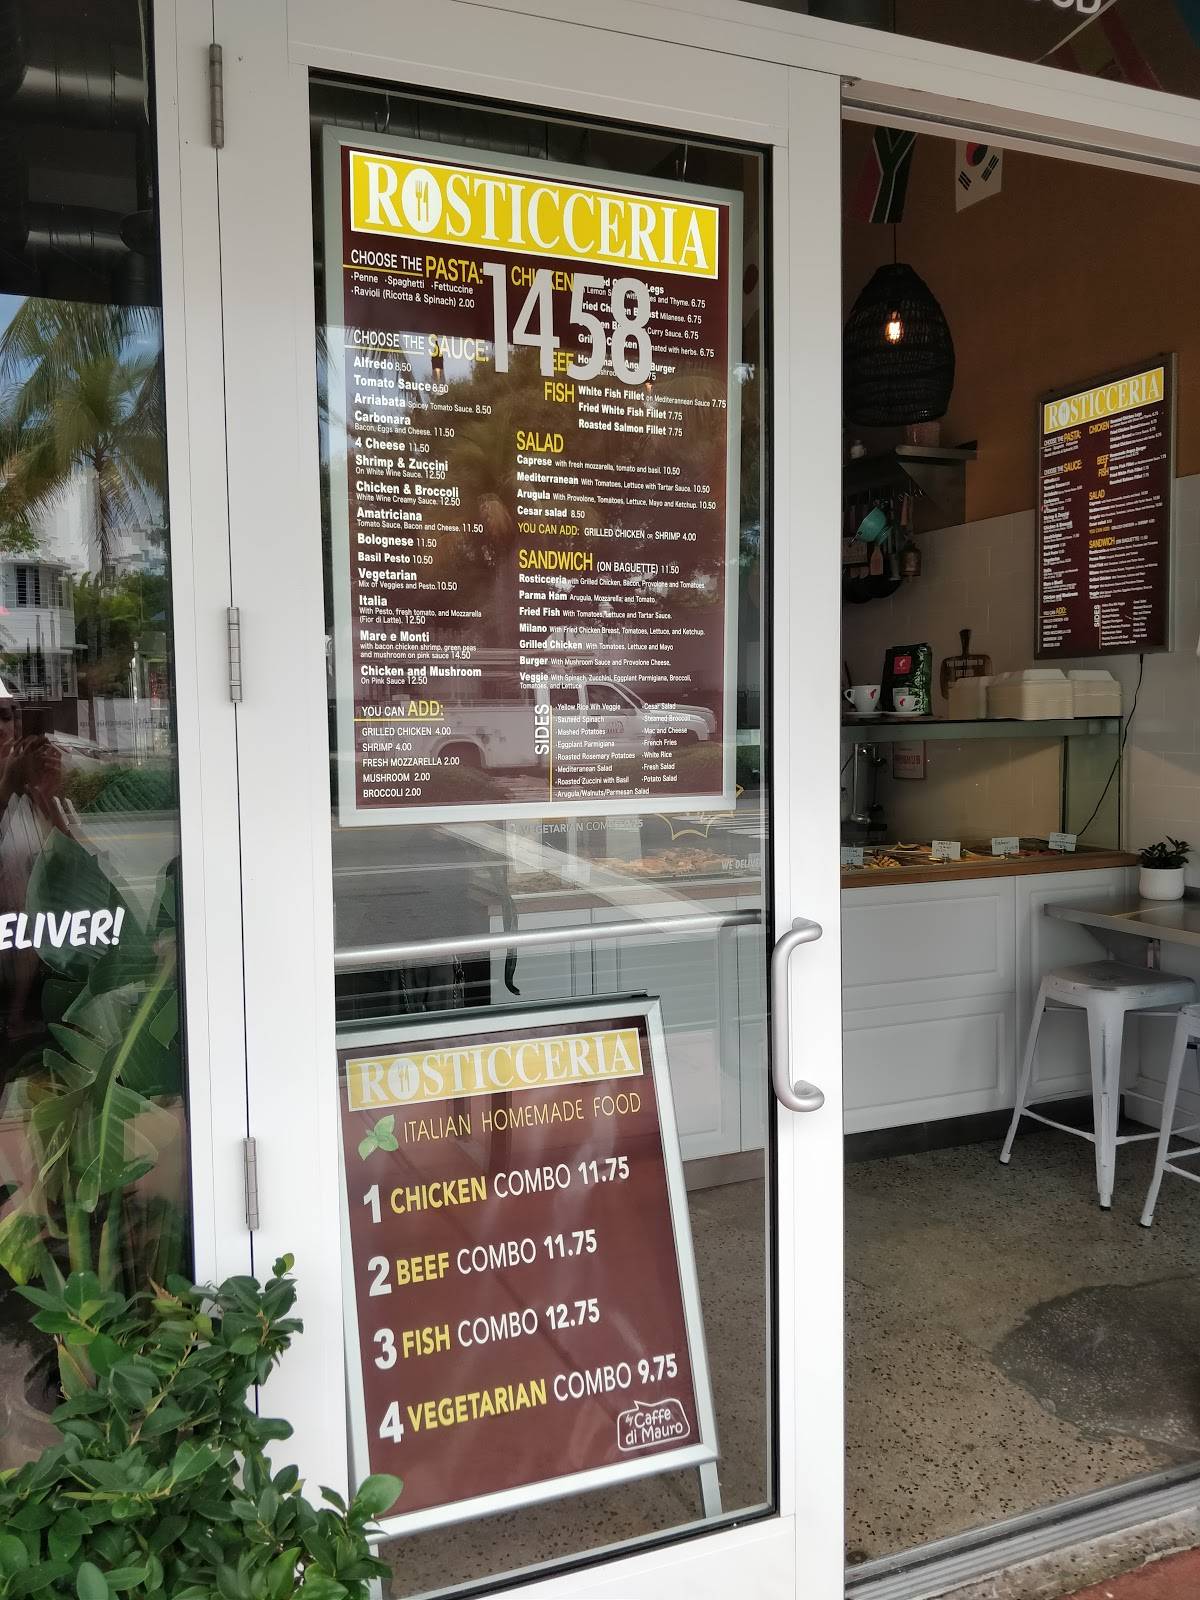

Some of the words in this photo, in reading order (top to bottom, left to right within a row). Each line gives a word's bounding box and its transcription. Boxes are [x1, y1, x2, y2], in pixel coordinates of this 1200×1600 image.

[365, 161, 709, 270] ROSTICCERIA
[351, 249, 398, 268] CHOOSE
[401, 256, 422, 271] THE
[426, 256, 483, 284] PASTA:
[354, 272, 378, 283] Penne
[388, 276, 424, 289] Spaghetti
[434, 281, 473, 294] Fettuccine
[354, 287, 380, 298] Ravioli
[383, 290, 413, 302] (Ricotta
[424, 294, 456, 307] Spinach)
[459, 298, 474, 308] 2.00
[691, 299, 706, 309] 6.75
[483, 262, 653, 385] 1458
[687, 315, 702, 324] 6.75
[685, 330, 699, 339] 6.75
[353, 329, 399, 347] CHOOSE
[403, 335, 424, 350] THE
[428, 334, 489, 362] SAUCE:
[700, 349, 714, 357] 6.75
[354, 356, 393, 370] Alfredo
[354, 374, 394, 388] Tomato
[398, 378, 431, 392] Sauce
[544, 381, 575, 403] FISH
[578, 385, 602, 396] White
[605, 388, 621, 398] Fish
[624, 389, 644, 400] Fillet
[354, 393, 406, 408] Arriabata
[476, 404, 492, 414] 8.50
[712, 399, 726, 408] 7.75
[1048, 372, 1160, 430] ROSTICCERIA
[354, 410, 411, 425] Carbonara
[578, 402, 599, 413] Fried
[602, 404, 625, 415] White
[627, 405, 643, 417] Fish
[646, 407, 666, 419] Fillet
[668, 412, 682, 421] 7.75
[434, 427, 454, 437] 11.50
[578, 419, 611, 431] Roasted
[614, 421, 643, 434] Salmon
[646, 424, 666, 435] Fillet
[668, 427, 682, 437] 7.75
[355, 437, 362, 448] 4
[366, 438, 406, 451] Cheese
[516, 430, 564, 453] SALAD
[356, 455, 393, 469] Shrimp
[398, 457, 405, 469] &
[409, 458, 448, 471] Zuccini
[517, 454, 552, 467] Caprese
[426, 470, 445, 480] 12.50
[663, 466, 680, 475] 10.50
[517, 472, 579, 485] Mediterranean
[356, 481, 399, 494] Chicken
[403, 484, 411, 495] &
[415, 485, 459, 498] Broccoli
[517, 489, 550, 501] Arugula
[693, 484, 710, 493] 10.50
[1089, 489, 1105, 500] SALAD
[440, 497, 460, 507] 12.50
[699, 501, 716, 510] 10.50
[357, 507, 422, 521] Amatriciana
[517, 506, 542, 516] Cesar
[545, 507, 567, 518] salad
[463, 523, 483, 533] 11.50
[518, 523, 537, 533] YOU
[539, 524, 557, 535] CAN
[560, 525, 579, 536] ADD:
[584, 527, 614, 538] GRILLED
[615, 529, 645, 539] CHICKEN
[655, 531, 680, 541] SHRIMP
[682, 532, 696, 541] 4.00
[358, 533, 414, 548] Bolognese
[417, 538, 437, 548] 11.50
[358, 552, 381, 562] Basil
[384, 553, 410, 563] Pesto
[412, 555, 433, 564] 10.50
[519, 550, 593, 571] SANDWICH
[597, 562, 612, 573] (ON
[614, 562, 658, 574] BAGUETTE)
[358, 568, 417, 582] Vegetarian
[519, 574, 567, 585] Rosticceria
[437, 582, 457, 590] 10.50
[359, 595, 387, 606] Italia
[519, 590, 547, 600] Parma
[549, 591, 567, 601] Ham
[519, 607, 540, 616] Fried
[543, 607, 560, 616] Fish
[406, 616, 426, 625] 12.50
[519, 623, 547, 633] Milano
[360, 630, 387, 642] Mare
[400, 631, 430, 642] Monti
[519, 640, 547, 649] Grilled
[550, 640, 582, 649] Chicken
[451, 651, 471, 660] 14.50
[519, 656, 548, 666] Burger
[361, 665, 403, 676] Chicken
[408, 666, 426, 677] and
[430, 666, 482, 677] Mushroom
[520, 672, 548, 683] Veggie
[408, 676, 428, 685] 12.50
[362, 706, 381, 716] YOU
[384, 706, 404, 716] CAN
[408, 700, 444, 716] ADD:
[362, 727, 395, 736] GRILLED
[397, 727, 432, 735] CHICKEN
[435, 727, 451, 735] 4.00
[534, 704, 550, 755] SIDES
[362, 743, 392, 751] SHRIMP
[396, 742, 411, 751] 4.00
[362, 758, 388, 767] FRESH
[390, 758, 442, 766] MOZZARELLA
[444, 757, 459, 765] 2.00
[363, 773, 410, 782] MUSHROOM
[414, 772, 430, 781] 2.00
[363, 789, 403, 797] BROCCOLI
[405, 788, 421, 796] 2.00
[0, 907, 125, 950] ELIVER!
[360, 1032, 636, 1105] ROSTICCERIA
[404, 1114, 472, 1143] ITALIAN
[481, 1099, 584, 1134] HOMEMADE
[593, 1092, 642, 1118] FOOD
[363, 1184, 382, 1225] 1
[390, 1175, 488, 1215] CHICKEN
[493, 1163, 572, 1199] COMBO
[577, 1156, 630, 1185] 11.75
[367, 1255, 392, 1297] 2
[396, 1252, 450, 1286] BEEF
[457, 1238, 537, 1275] COMBO
[543, 1229, 598, 1260] 11.75
[372, 1328, 398, 1370] 3
[402, 1324, 451, 1359] FISH
[458, 1308, 538, 1347] COMBO
[545, 1298, 600, 1330] 12.75
[379, 1401, 404, 1444] 4
[407, 1378, 547, 1432] VEGETARIAN
[554, 1362, 632, 1402] COMBO
[637, 1353, 678, 1385] 9.75
[634, 1408, 672, 1430] Caffe
[641, 1421, 683, 1443] Mauro
